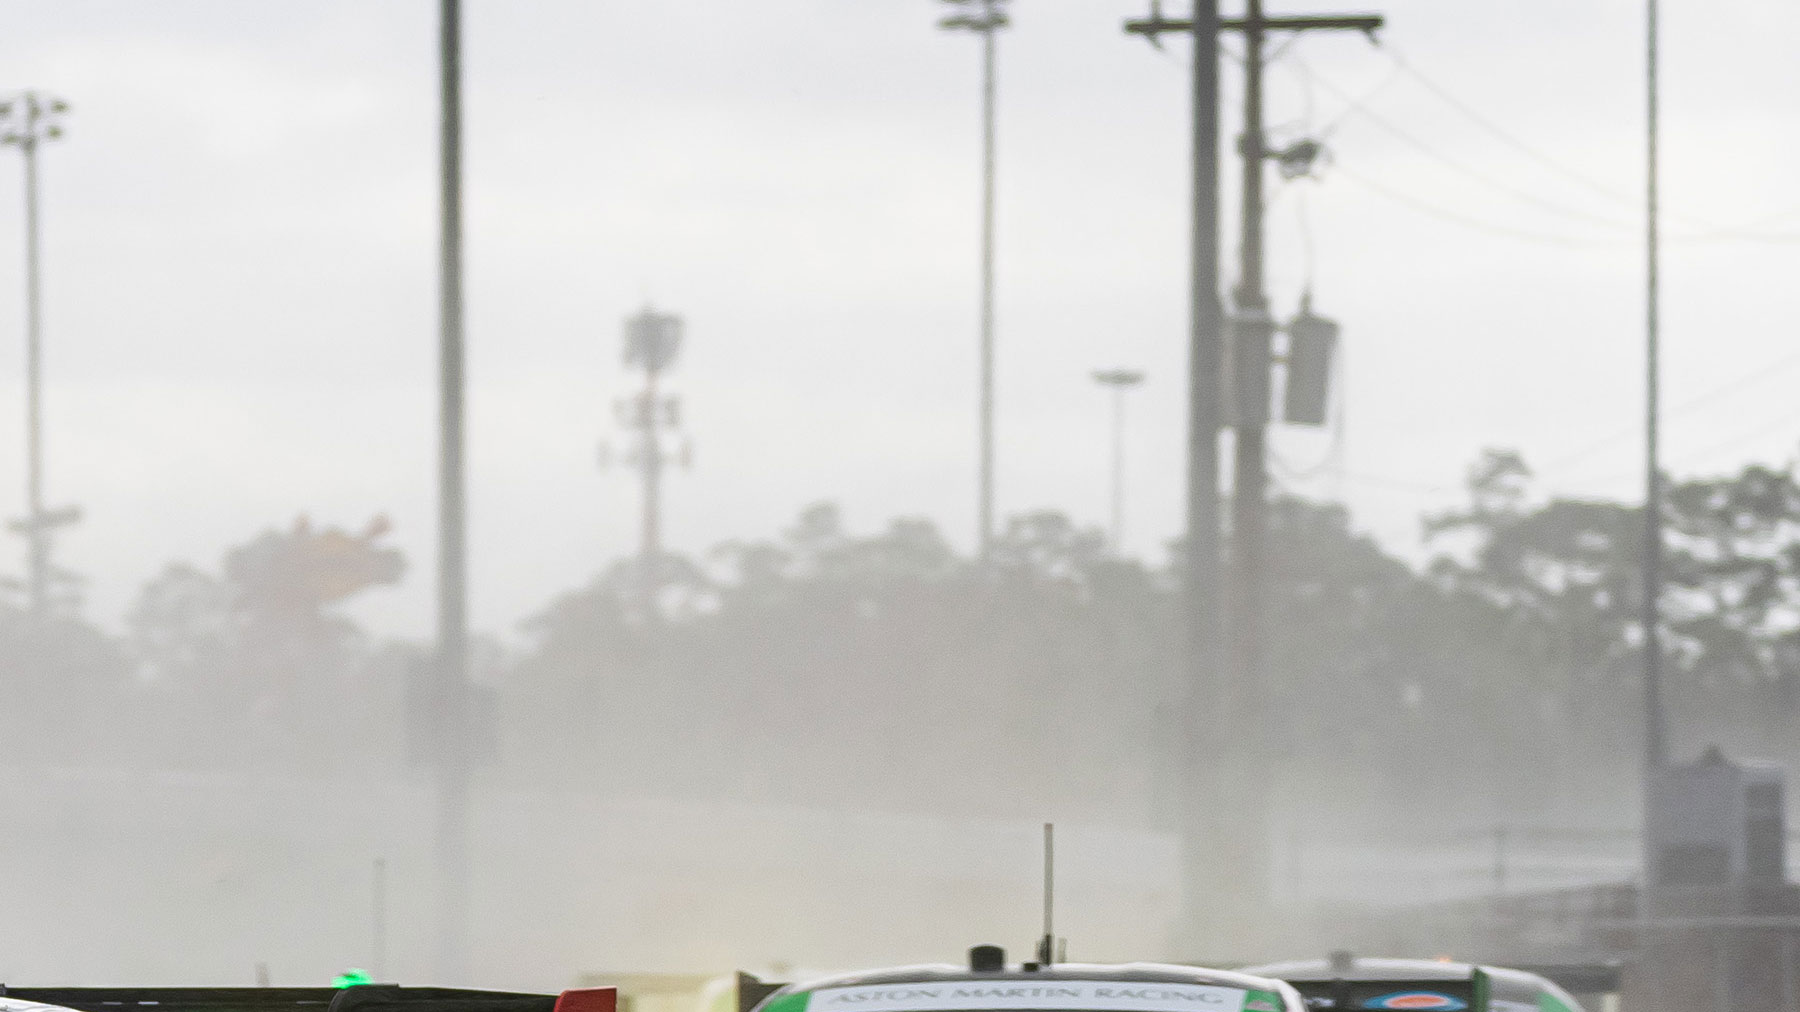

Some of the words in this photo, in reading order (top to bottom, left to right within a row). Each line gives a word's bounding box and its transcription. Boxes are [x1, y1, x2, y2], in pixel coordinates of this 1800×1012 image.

[830, 989, 941, 1005] ASTON
[951, 986, 1080, 999] MARTIN
[1093, 987, 1225, 1004] RACING
